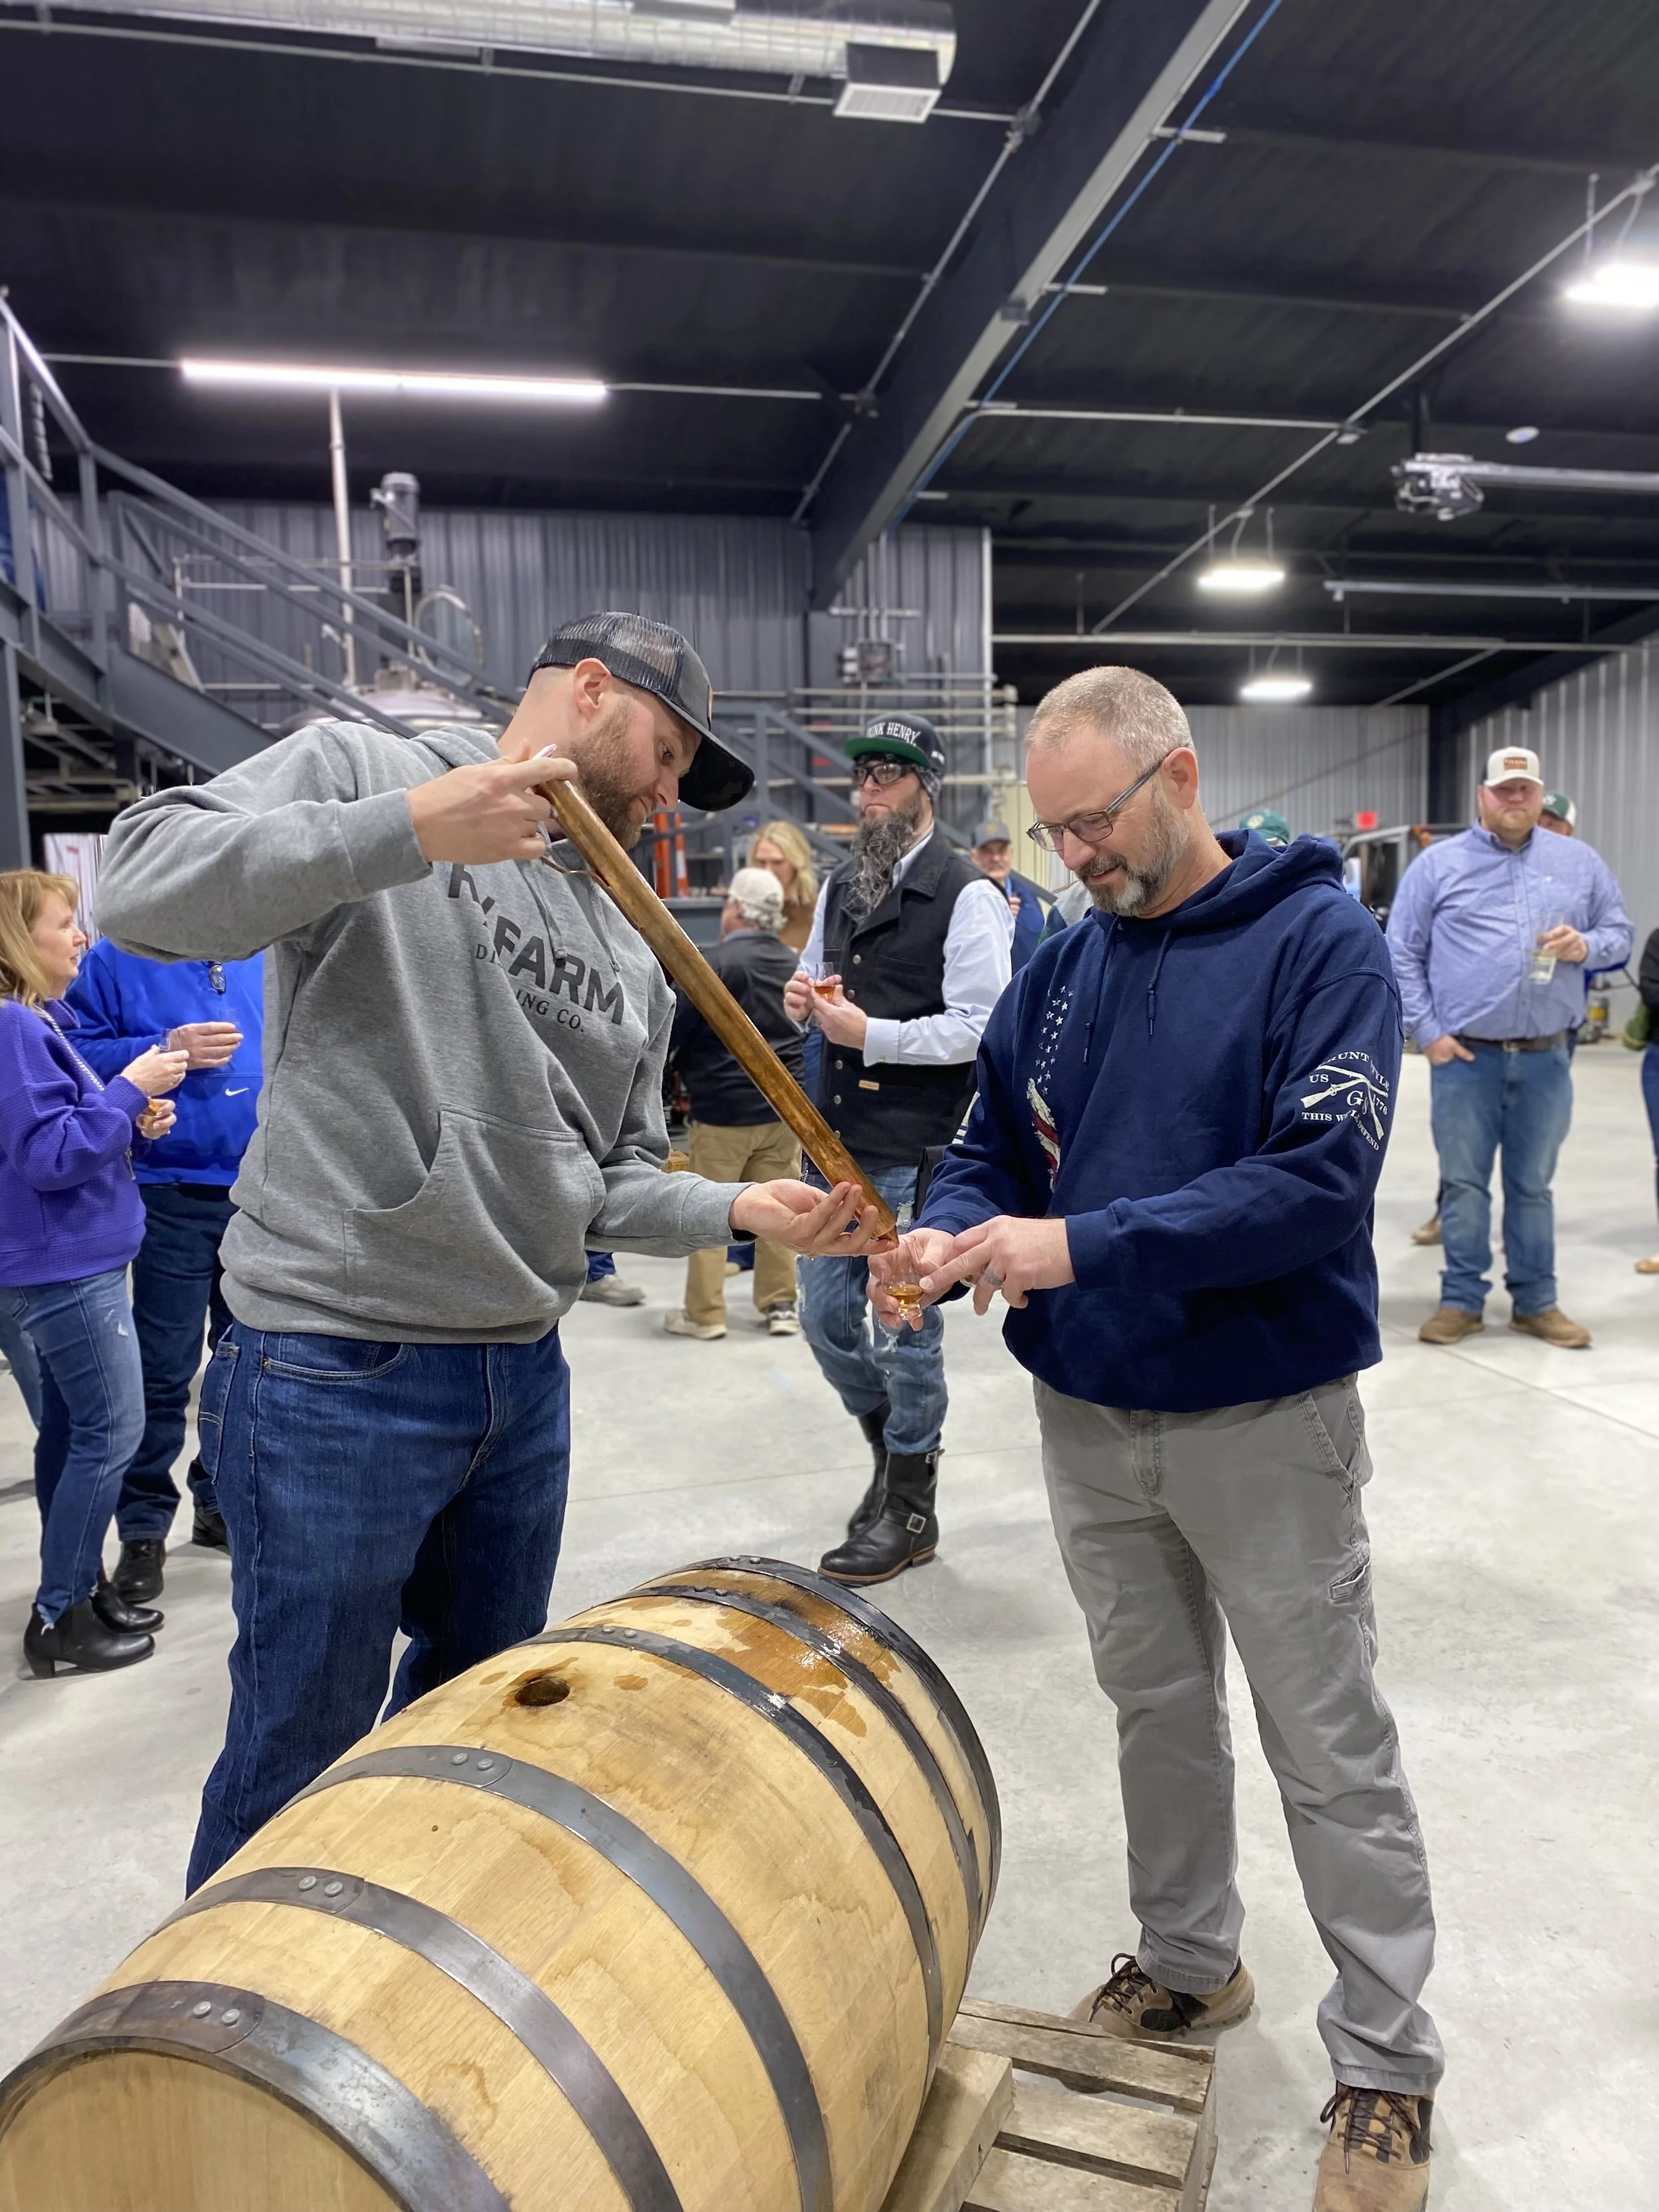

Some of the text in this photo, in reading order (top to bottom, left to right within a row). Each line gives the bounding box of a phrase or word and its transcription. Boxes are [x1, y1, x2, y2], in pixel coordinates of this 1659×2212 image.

[494, 915, 624, 1025] FARM
[557, 1009, 584, 1033] CO.
[1309, 1074, 1329, 1083] US
[1346, 1090, 1364, 1106] G
[1301, 1112, 1333, 1122] THIS
